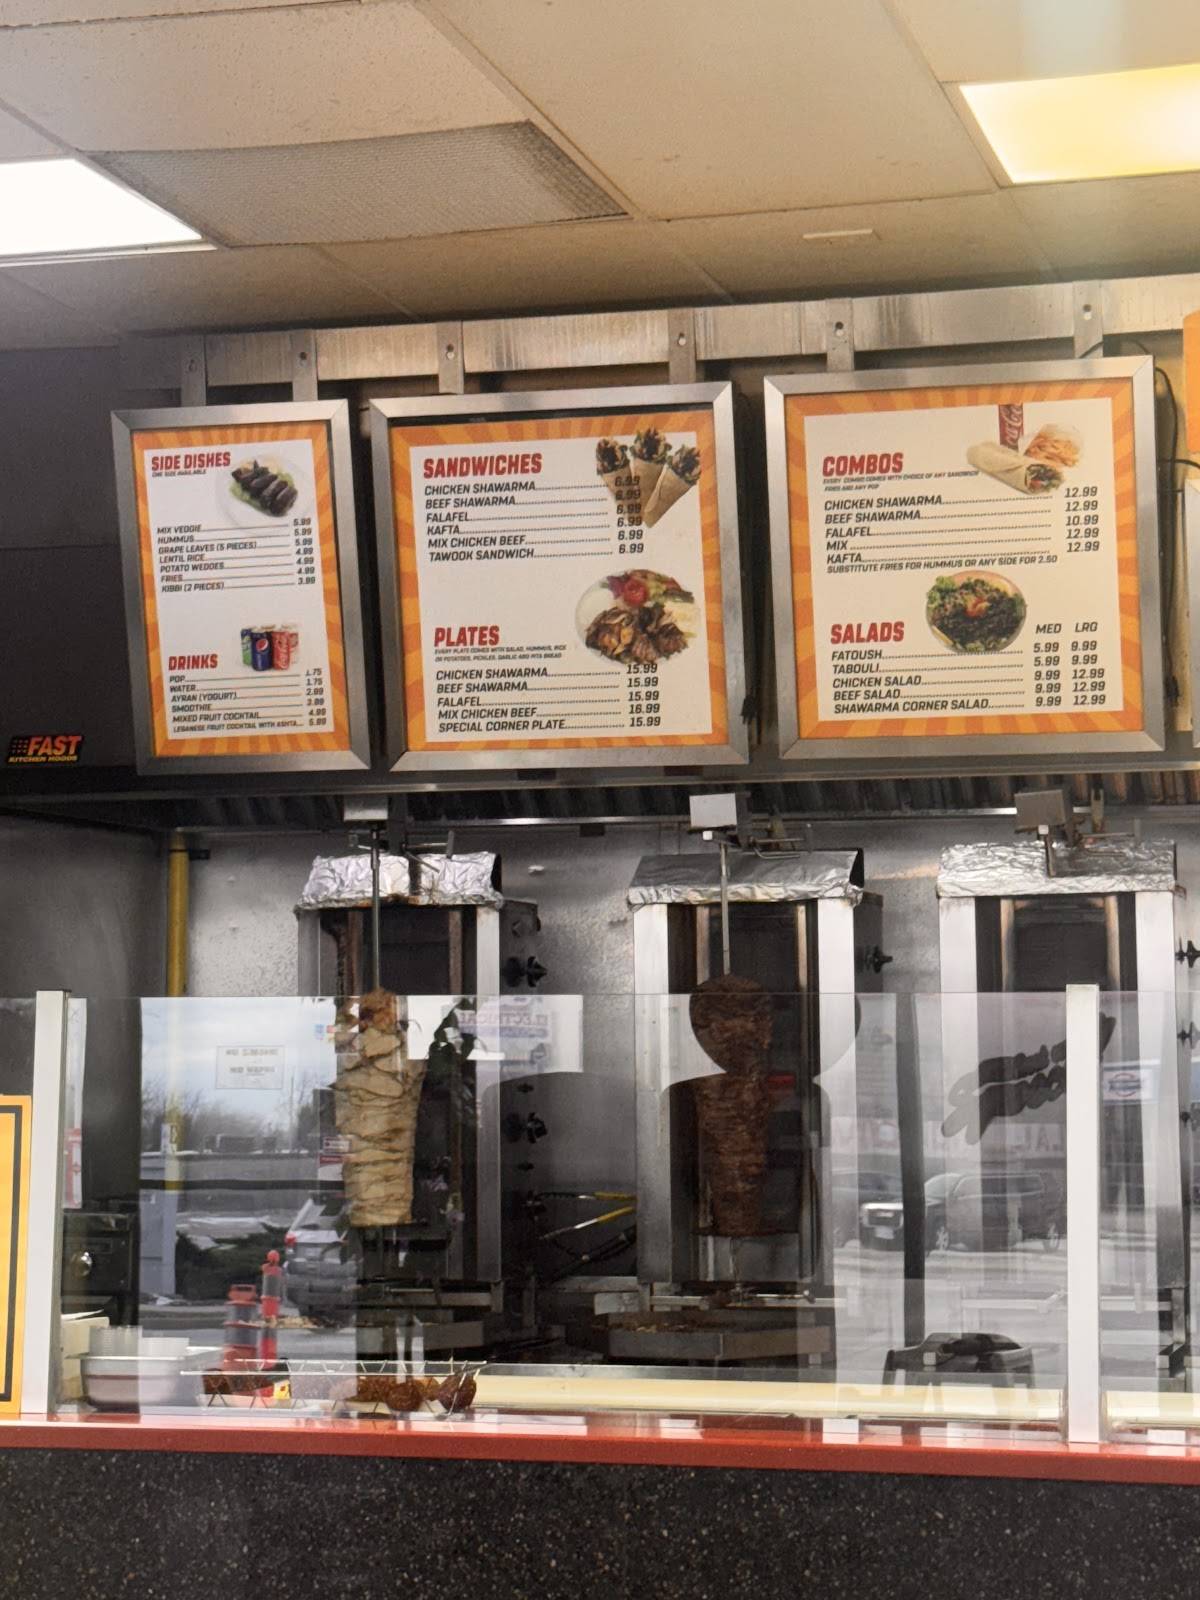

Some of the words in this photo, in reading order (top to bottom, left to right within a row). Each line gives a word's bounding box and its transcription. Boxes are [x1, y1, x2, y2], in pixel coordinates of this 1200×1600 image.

[152, 455, 180, 471] SIDE
[184, 452, 231, 469] DISHES
[424, 453, 542, 478] SANDWICHES
[822, 452, 904, 476] COMBOS
[425, 484, 470, 496] CHICKEN
[473, 481, 535, 494] SHAWARMA
[426, 498, 450, 509] BEEF
[454, 496, 515, 508] SHAWARMA
[824, 498, 873, 510] CHICKEN
[876, 495, 942, 508] SHAWARMA
[1064, 486, 1098, 498] 12.99
[426, 512, 470, 523] FALAFEL
[617, 504, 641, 514] 6.99
[825, 512, 852, 524] BEEF
[855, 510, 920, 522] SHAWARMA
[1066, 500, 1098, 512] 12.99
[174, 525, 201, 533] VEGGIE
[427, 525, 459, 536] KAFTA
[617, 516, 642, 528] 6.99
[826, 526, 872, 538] FALAFEL
[1066, 515, 1098, 526] 10.99
[158, 536, 194, 544] HUMMUS
[159, 545, 184, 554] GRAPE
[186, 544, 215, 553] LEAVES
[227, 542, 257, 550] PIECES)
[428, 537, 448, 548] MIX
[451, 536, 496, 547] CHICKEN
[500, 534, 525, 545] BEEF
[618, 530, 643, 541] 6.99
[826, 540, 848, 550] MIX
[1066, 528, 1099, 539] 12.99
[187, 554, 205, 562] RICE
[429, 550, 473, 561] TAWOOK
[476, 548, 534, 560] SANDWICH
[619, 543, 644, 554] 6.99
[827, 552, 862, 564] KAFTA
[1068, 541, 1100, 552] 12.99
[160, 564, 189, 572] POTATO
[192, 563, 224, 571] WEDGES
[827, 562, 878, 574] SUBSTITUTE
[880, 561, 904, 571] FRIES
[906, 560, 922, 570] FOR
[924, 559, 962, 570] HUMMUS
[965, 558, 976, 567] OR
[979, 558, 996, 566] ANY
[998, 557, 1017, 566] SIDE
[1020, 556, 1036, 564] FOR
[1038, 555, 1057, 564] 2.50
[184, 584, 192, 592] (2
[434, 626, 500, 646] PLATES
[830, 622, 904, 644] SALADS
[1036, 623, 1062, 634] MED
[1075, 622, 1098, 633] LRG
[832, 649, 882, 661] FATOUSH
[1033, 642, 1059, 653] 5.99
[1071, 640, 1097, 652] 9.99
[169, 654, 217, 670] DRINKS
[833, 663, 879, 674] TABOULI
[1034, 656, 1060, 667] 5.99
[1072, 654, 1098, 665] 9.99
[170, 675, 185, 683] POP
[436, 669, 483, 680] CHICKEN
[486, 667, 548, 679] SHAWARMA
[627, 664, 657, 674] 15.99
[833, 676, 882, 688] CHICKEN
[884, 675, 922, 686] SALAD
[1034, 670, 1060, 680] 9.99
[1072, 668, 1104, 680] 12.99
[437, 683, 462, 693] BEEF
[466, 680, 528, 692] SHAWARMA
[627, 677, 658, 687] 15.99
[834, 690, 860, 701] BEEF
[864, 688, 900, 700] SALAD
[1035, 682, 1061, 694] 9.99
[1073, 681, 1105, 692] 12.99
[172, 694, 196, 702] AYRAN
[199, 692, 237, 701] (YOGURT)
[438, 696, 482, 707] FALAFEL
[628, 691, 659, 701] 15.99
[834, 702, 900, 714] SHAWARMA
[902, 700, 948, 712] CORNER
[951, 698, 988, 710] SALAD
[1036, 696, 1061, 707] 9.99
[1074, 694, 1106, 706] 12.99
[172, 704, 212, 712] SMOOTHIE
[439, 709, 458, 720] MIX
[461, 707, 507, 719] CHICKEN
[511, 706, 537, 717] BEEF
[173, 714, 197, 723] MIXED
[199, 713, 222, 721] FRUIT
[224, 712, 259, 720] COCKTAIL
[439, 721, 483, 732] SPECIAL
[486, 720, 529, 731] CORNER
[532, 719, 565, 730] PLATE
[630, 717, 661, 727] 15.99
[174, 725, 205, 733] LEBANESE
[207, 723, 225, 731] FRUIT
[227, 722, 256, 730] COCKTAIL
[28, 736, 82, 755] FAST
